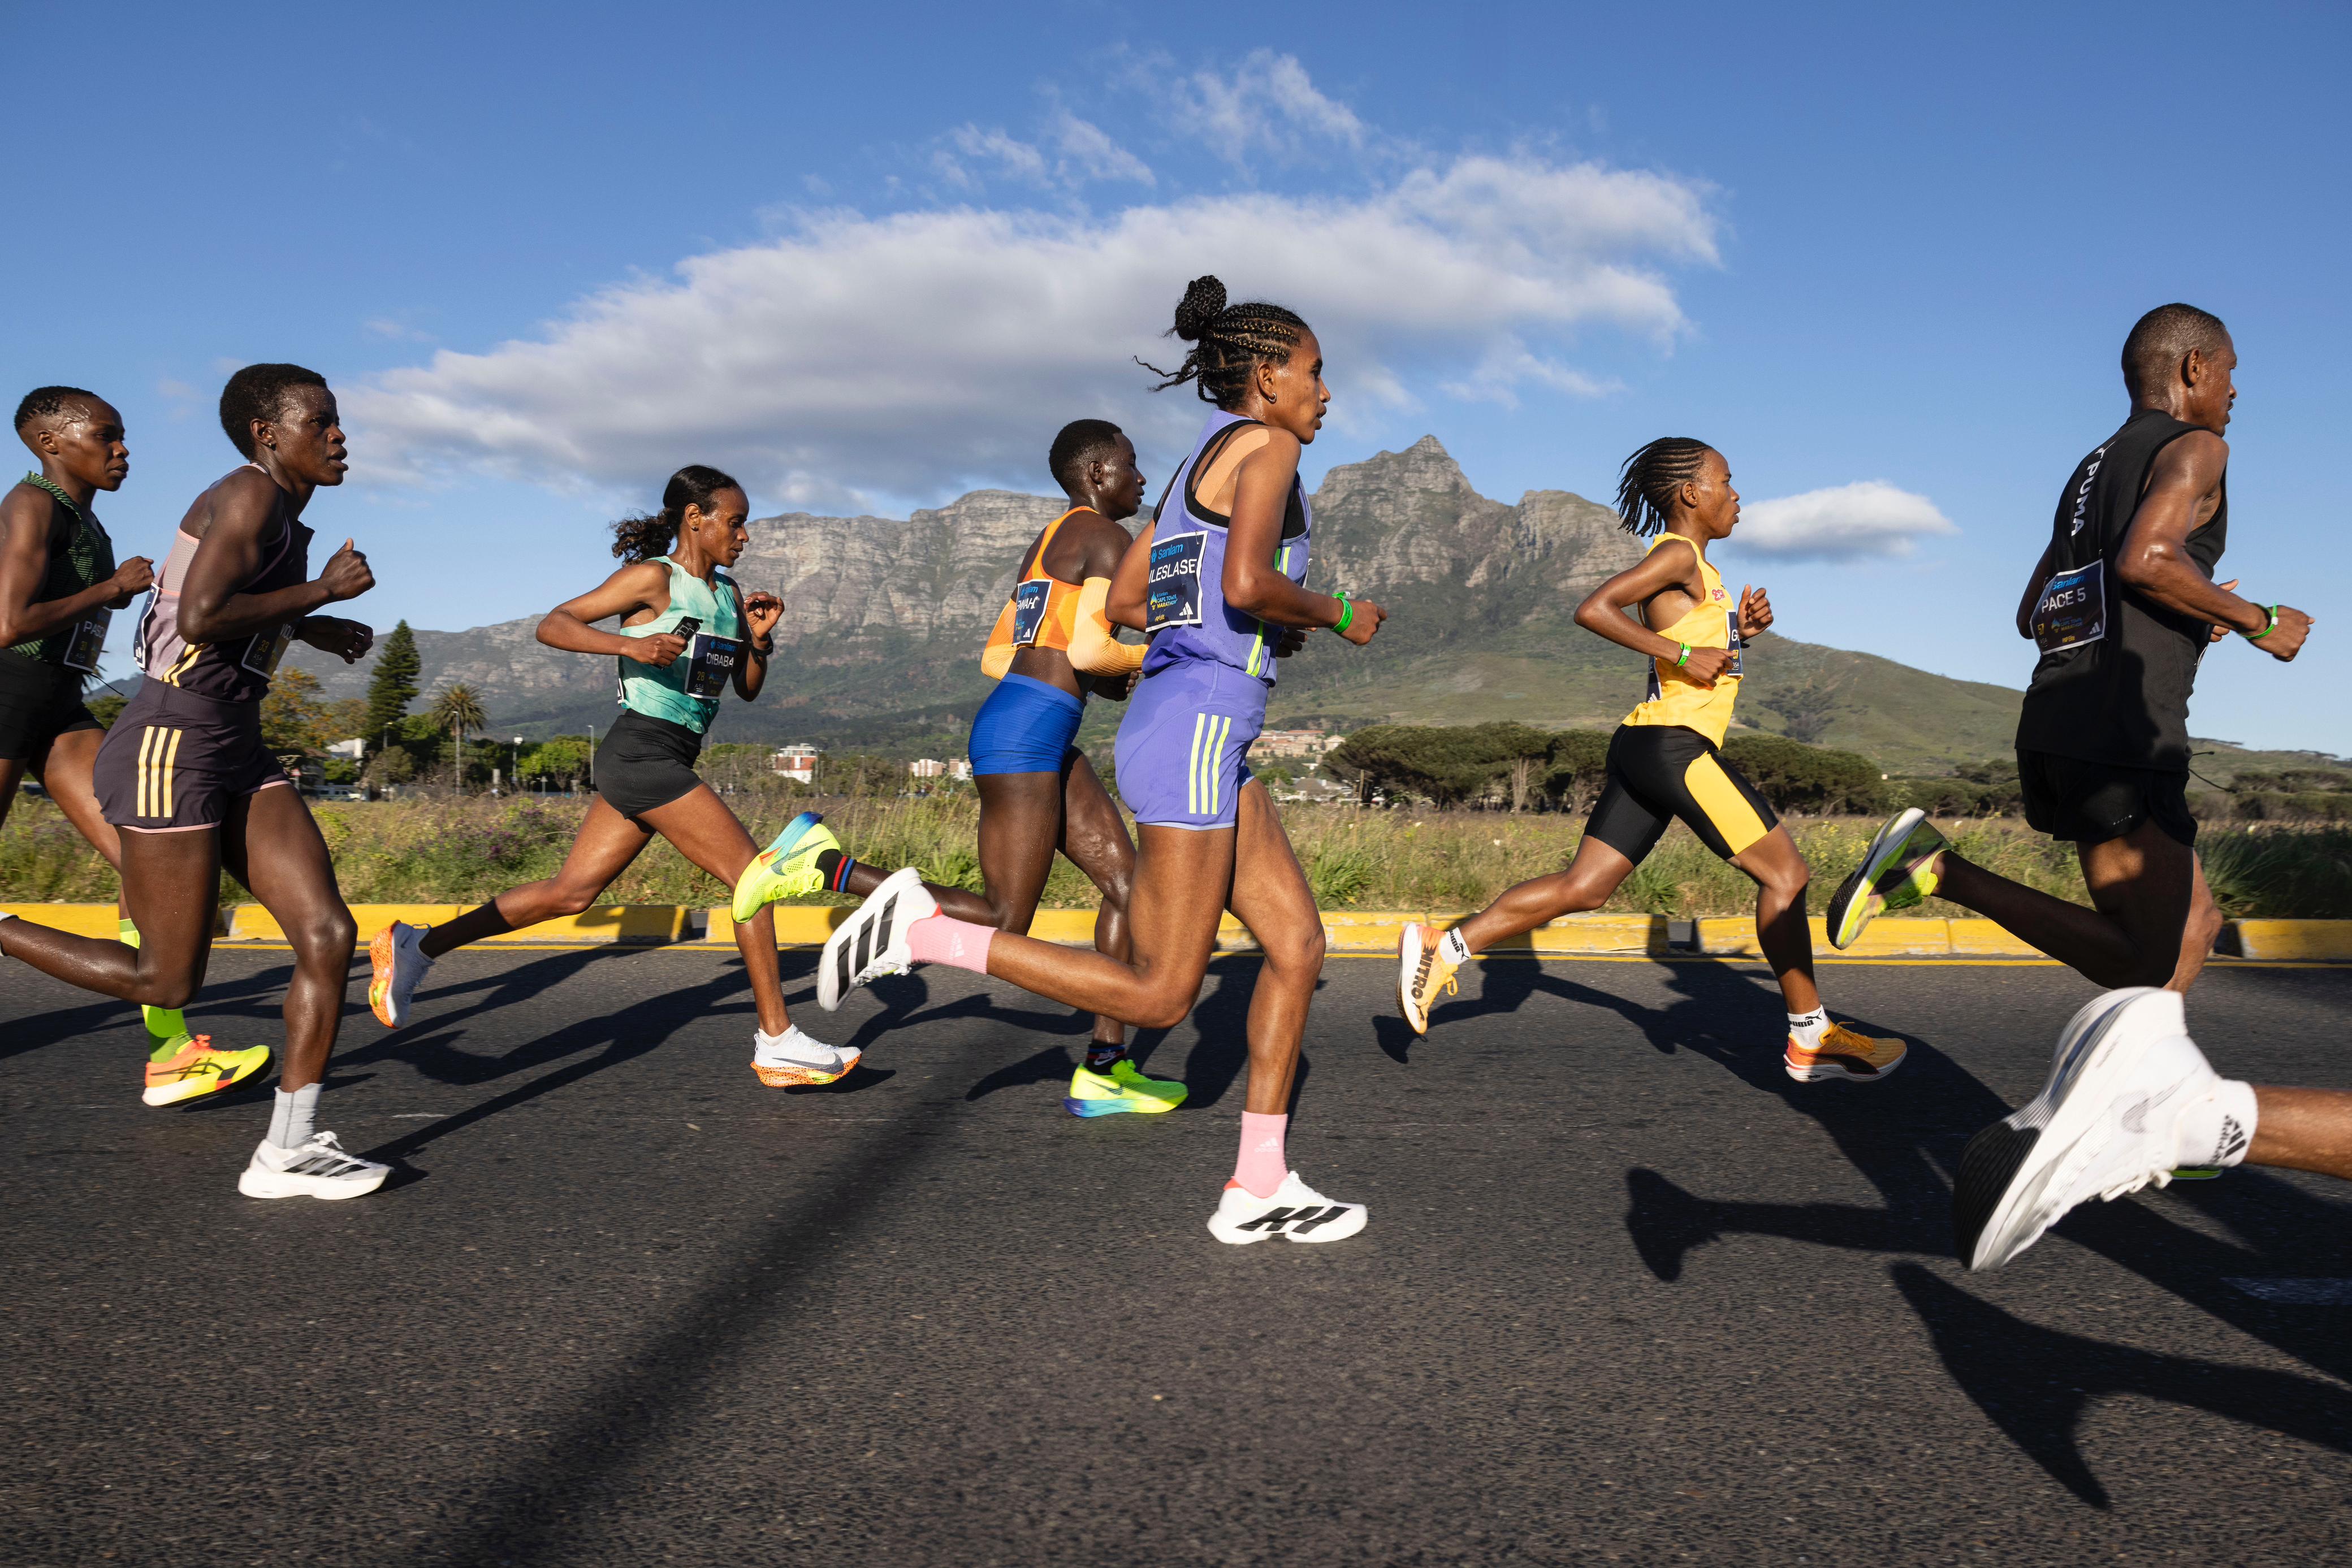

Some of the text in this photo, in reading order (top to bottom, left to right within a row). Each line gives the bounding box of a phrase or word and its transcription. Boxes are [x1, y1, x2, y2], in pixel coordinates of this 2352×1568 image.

[2071, 460, 2102, 536] PUMA
[1158, 544, 1183, 560] Sanlam
[1148, 558, 1197, 584] ILESLASE
[2052, 575, 2085, 590] Sanlam
[1157, 599, 1178, 609] MARATHON
[2042, 587, 2086, 613] PACE 5
[2037, 623, 2044, 635] 57
[258, 640, 270, 652] 33
[706, 652, 734, 667] DIBABA
[1411, 943, 1437, 999] NITRO
